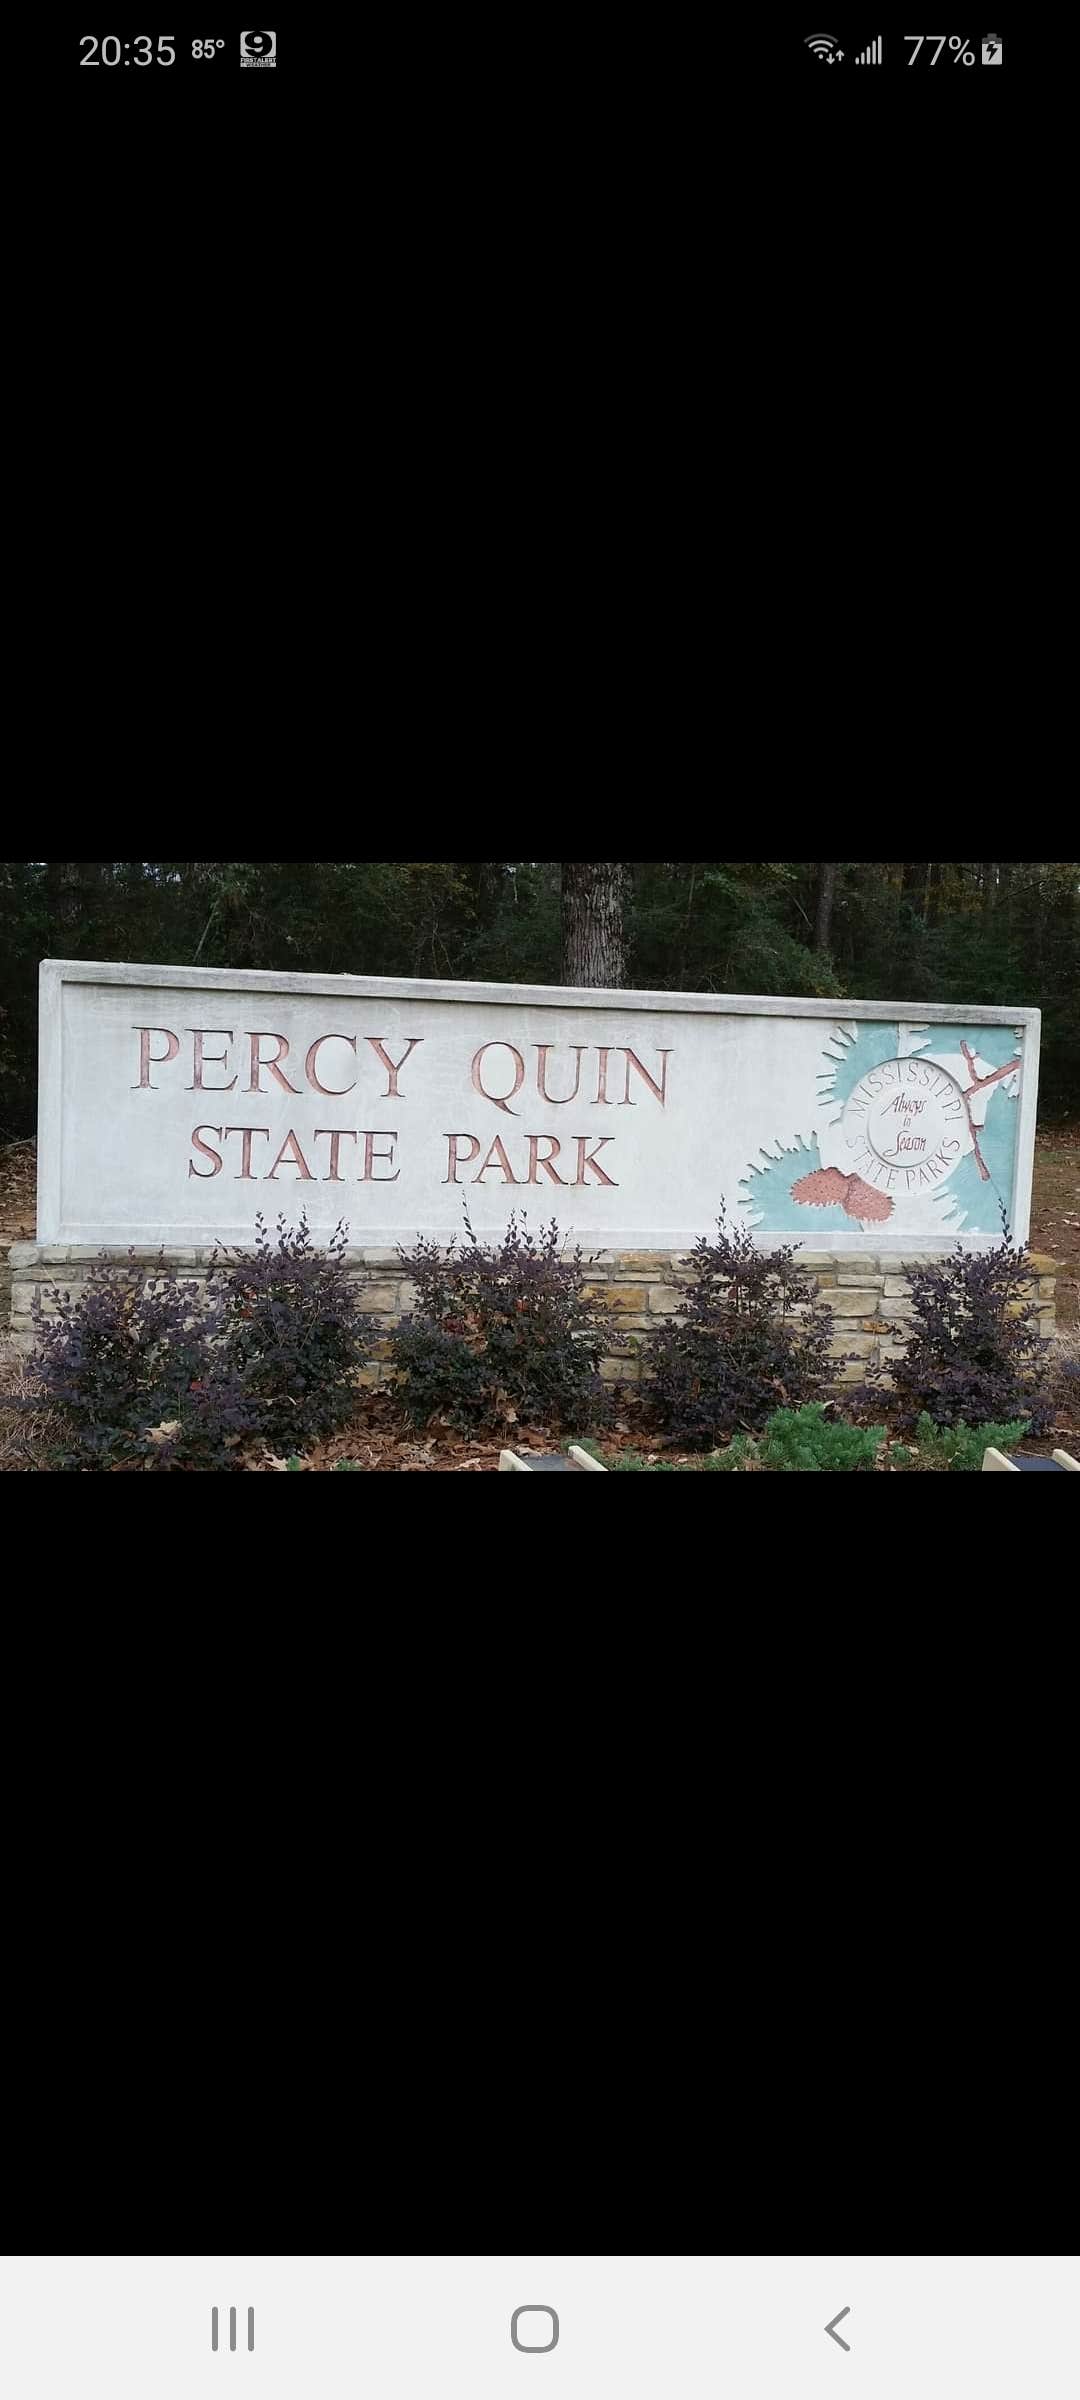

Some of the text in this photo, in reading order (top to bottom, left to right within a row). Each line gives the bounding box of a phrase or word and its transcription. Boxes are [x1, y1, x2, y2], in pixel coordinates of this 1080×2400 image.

[129, 1026, 675, 1116] PERCY QUIN
[847, 1061, 964, 1121] MISSISSIPPI
[880, 1092, 928, 1116] Always
[903, 1115, 912, 1127] in
[188, 1125, 620, 1187] STATE PARK
[846, 1134, 961, 1190] STATE PARKS
[882, 1130, 927, 1157] Season
